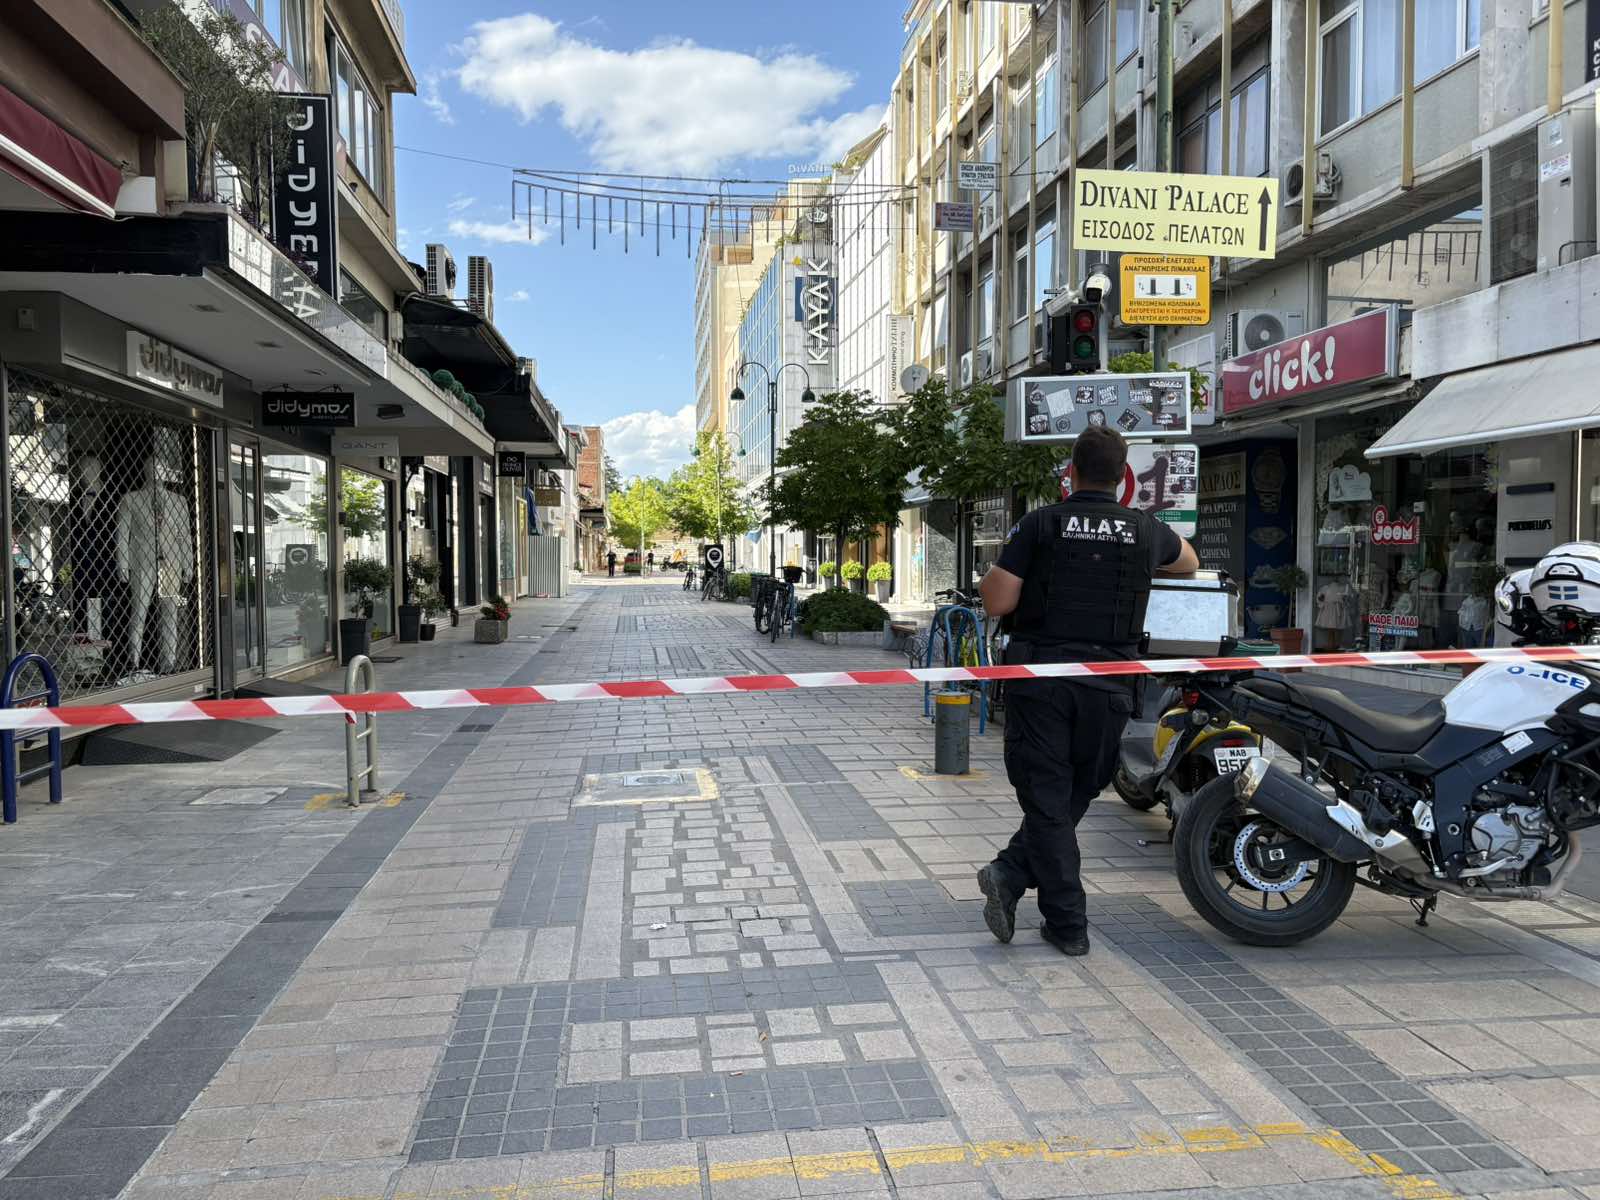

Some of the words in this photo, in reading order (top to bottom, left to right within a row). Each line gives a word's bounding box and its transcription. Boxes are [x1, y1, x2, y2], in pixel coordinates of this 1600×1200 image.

[1080, 180, 1158, 210] DIVANI
[1165, 184, 1249, 215] PALACE
[1082, 219, 1155, 241] ΕΙΣΟΔΟΣ
[1168, 223, 1245, 246] ΠΕΛΑΤΩΝ
[808, 259, 829, 365] KAYAK
[1249, 335, 1336, 400] click!
[267, 399, 351, 417] didymos
